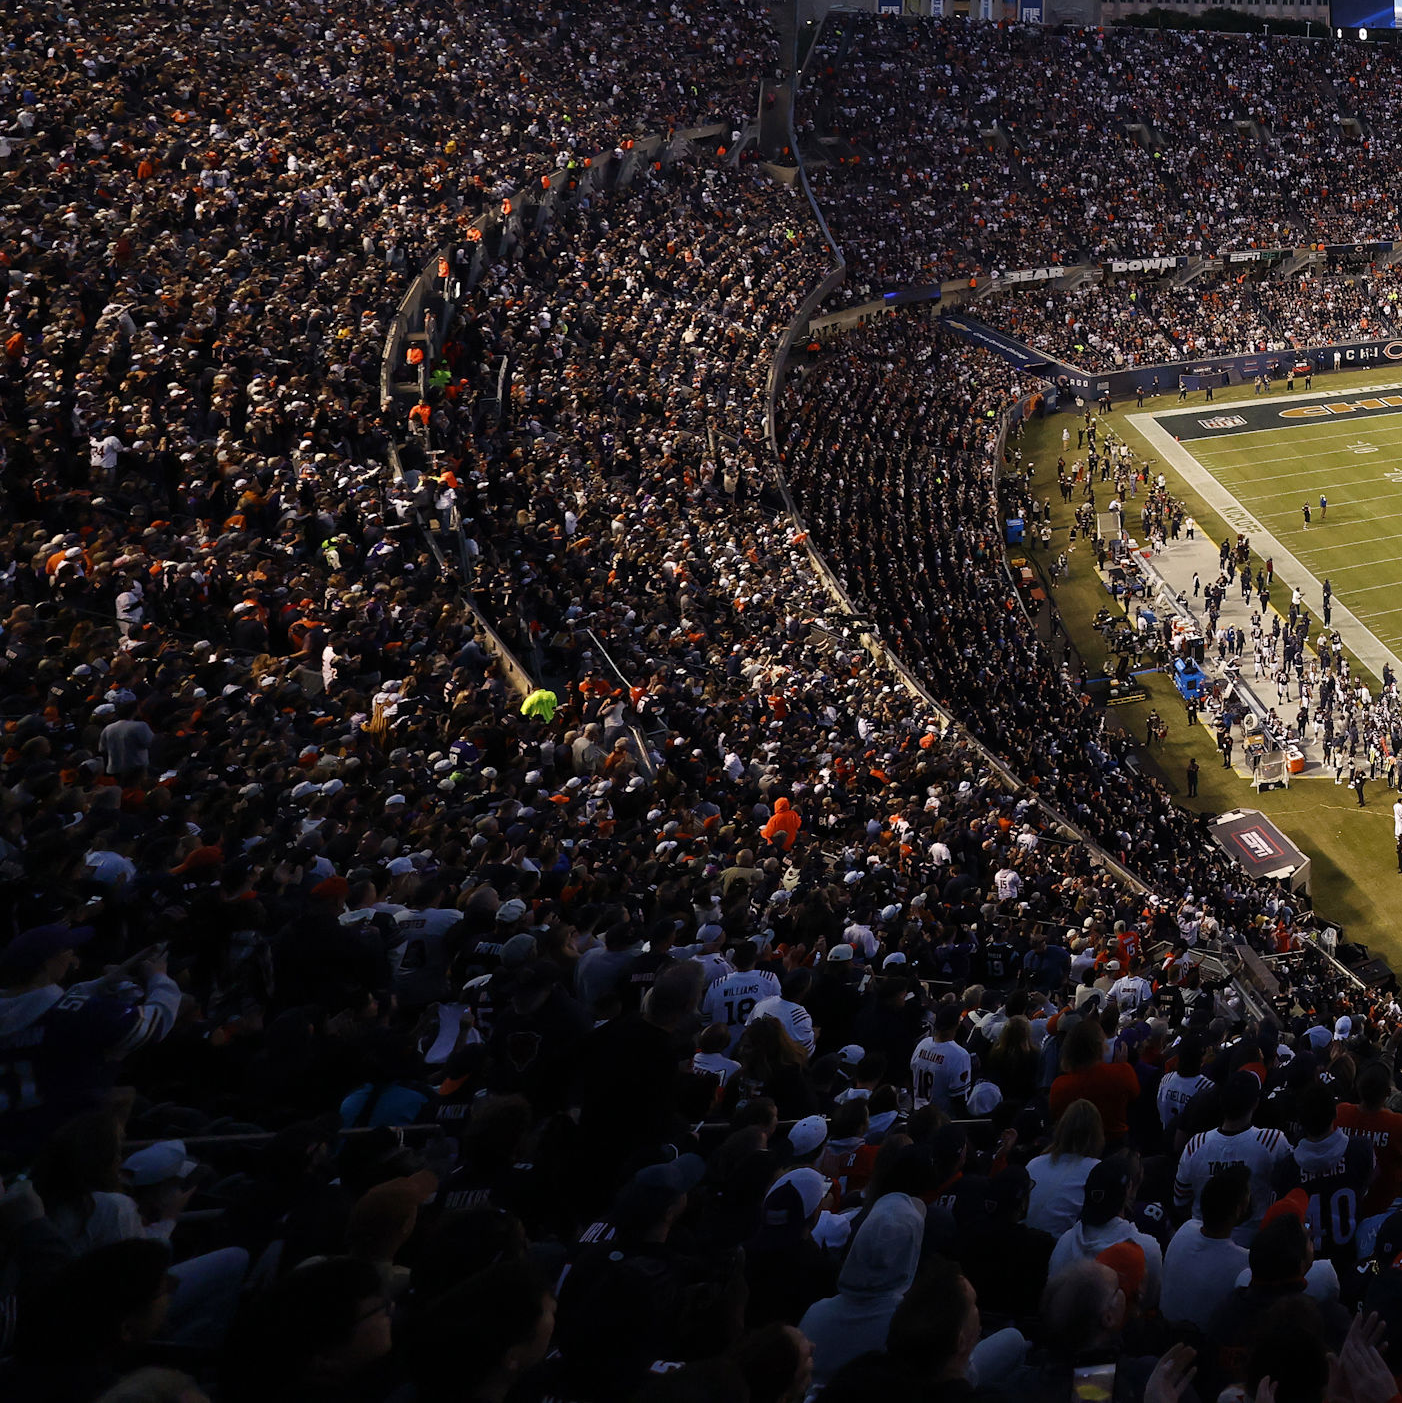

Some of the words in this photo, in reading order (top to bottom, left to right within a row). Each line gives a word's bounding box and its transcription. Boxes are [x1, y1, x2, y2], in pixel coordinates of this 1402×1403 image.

[1112, 257, 1176, 272] DOWN
[1230, 251, 1261, 263] ESPN
[1262, 250, 1281, 260] BET
[1005, 267, 1064, 284] BEAR
[1240, 831, 1274, 858] ESPN
[986, 960, 1005, 977] 19
[724, 983, 760, 998] WILLIAMS
[725, 998, 756, 1026] 18
[919, 1049, 945, 1065] WILLIAMS
[1165, 1089, 1192, 1104] FIELDS
[1306, 1188, 1357, 1248] 40
